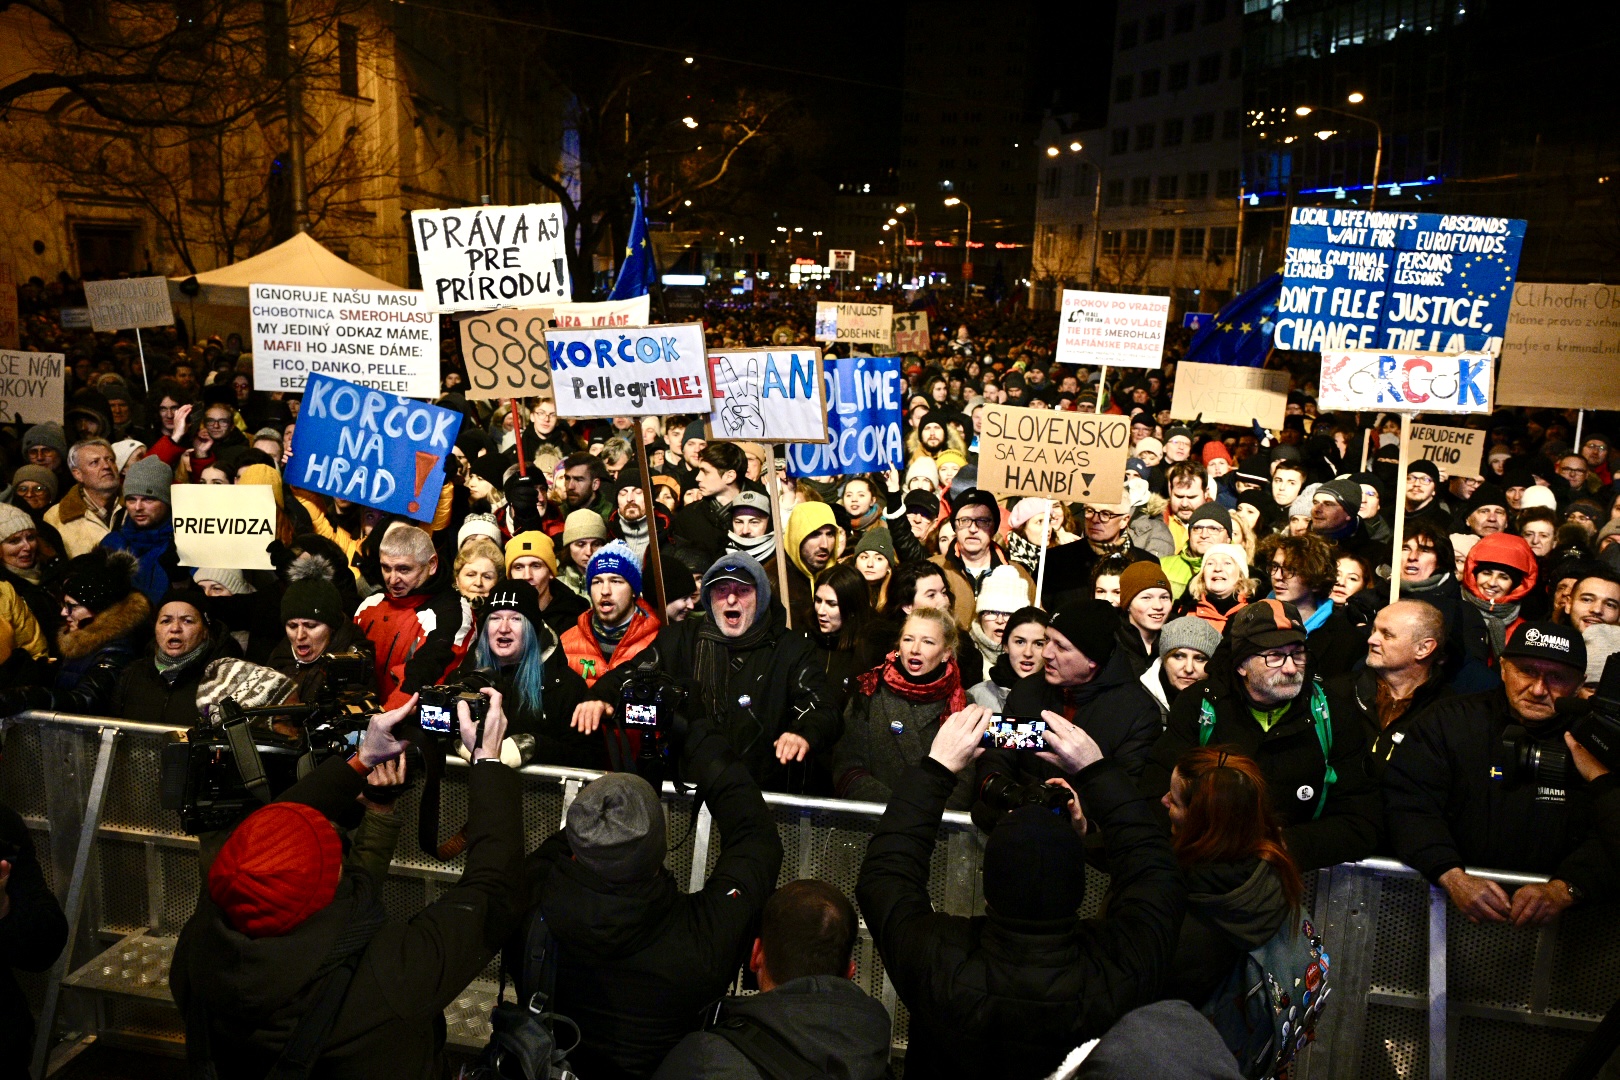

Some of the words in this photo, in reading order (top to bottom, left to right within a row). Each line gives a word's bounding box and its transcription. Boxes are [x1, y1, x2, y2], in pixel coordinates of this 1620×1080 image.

[418, 210, 529, 251] PRÁVA
[1290, 207, 1329, 226] LOCAL
[1332, 210, 1418, 230] DEFENDANTS
[1438, 215, 1512, 237] ABSCONDS,
[1327, 227, 1367, 246] WAIT
[1370, 229, 1395, 248] FOR
[1416, 231, 1507, 254] EUROFUNDS.
[464, 247, 522, 271] PRE
[1285, 247, 1322, 264] SLOVAK
[1326, 249, 1388, 268] CRIMINAL
[1397, 252, 1453, 273] PERSONS,
[436, 258, 564, 305] PRÍRODU!
[1284, 262, 1334, 280] LEARNED
[1347, 265, 1385, 282] THEIR
[1394, 269, 1445, 287] LESSONS.
[256, 288, 327, 303] IGNORUJE
[333, 289, 371, 304] NAŠU
[377, 295, 417, 306] MASU
[1065, 298, 1071, 306] 6
[1074, 299, 1109, 308] ROKOV
[1111, 301, 1126, 309] PO
[1129, 302, 1168, 312] VRAŽDE
[1278, 285, 1327, 314] DON'T
[1330, 286, 1385, 320] FLEE
[1388, 292, 1493, 333] JUSTICE,
[252, 306, 335, 319] CHOBOTNICA
[1104, 317, 1110, 325] A
[1113, 318, 1128, 326] VO
[1131, 318, 1163, 328] VLÁDE
[257, 323, 279, 334] MY
[281, 323, 331, 336] JEDINÝ
[336, 326, 382, 338] ODKAZ
[386, 326, 433, 342] MÁME,
[1065, 338, 1121, 349] MAFIÁNSKE
[1123, 342, 1160, 351] PRASCE
[1067, 326, 1081, 334] TIE
[1104, 329, 1161, 339] SMEROHLAS
[1273, 318, 1376, 352] CHANGE
[1386, 327, 1427, 351] THE
[263, 340, 302, 352] MAFII
[306, 342, 327, 353] HO
[331, 343, 375, 356] JASNE
[380, 342, 423, 357] DÁME:
[546, 334, 680, 371] KORČOK
[29, 354, 61, 378] NÁM
[272, 359, 309, 372] FICO,
[312, 361, 365, 375] DANKO,
[280, 375, 308, 389] BEŽ
[824, 359, 899, 414] OLÍME
[308, 379, 456, 447] KORČOK
[986, 411, 1127, 449] SLOVENSKO
[1410, 426, 1475, 445] NEBUDEME
[338, 429, 384, 466] NA
[995, 443, 1016, 462] SA
[1023, 445, 1047, 464] ZA
[1054, 447, 1090, 467] VÁS
[1422, 444, 1461, 464] TICHO
[304, 453, 396, 503] HRAD
[173, 517, 274, 536] PRIEVIDZA
[1540, 634, 1570, 648] YAMAHA
